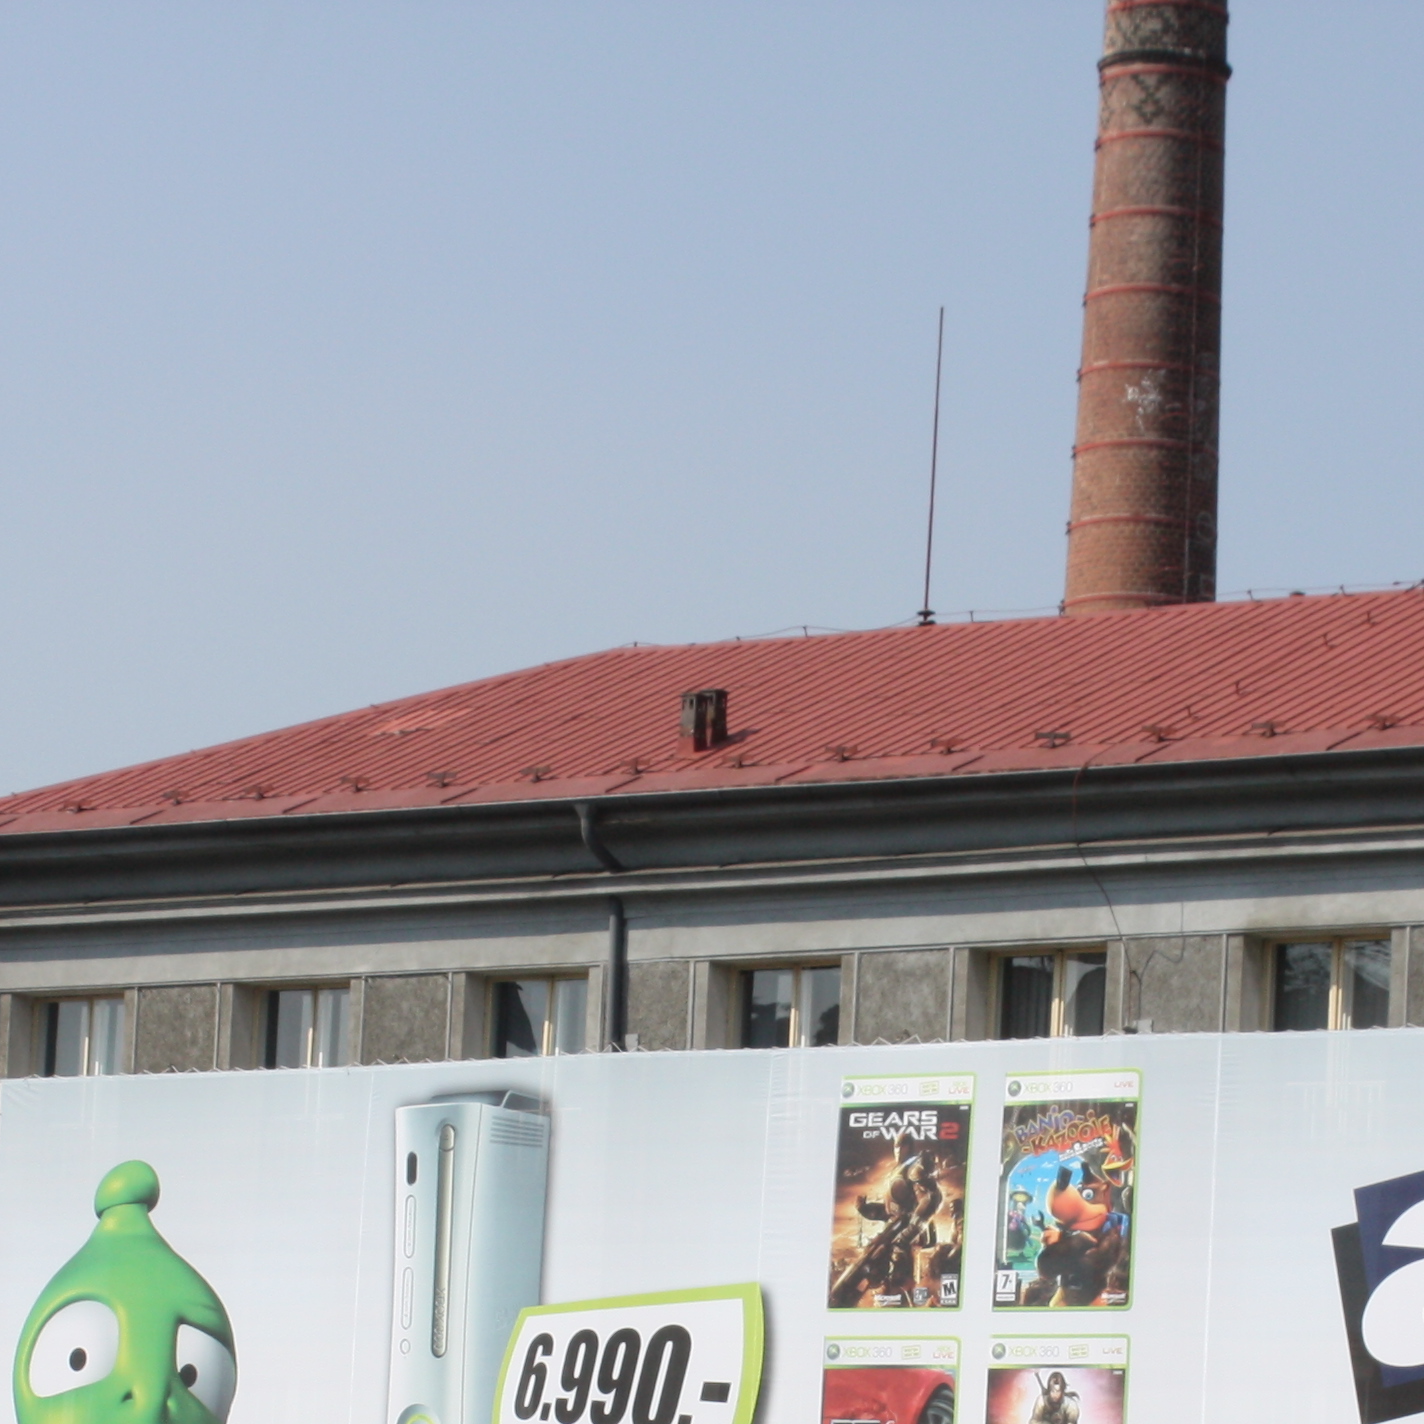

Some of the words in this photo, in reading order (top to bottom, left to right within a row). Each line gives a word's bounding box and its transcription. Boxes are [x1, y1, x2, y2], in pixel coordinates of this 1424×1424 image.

[849, 1111, 938, 1127] GEARS
[863, 1131, 880, 1139] OF
[880, 1126, 938, 1140] WAR
[939, 1122, 960, 1140] 2
